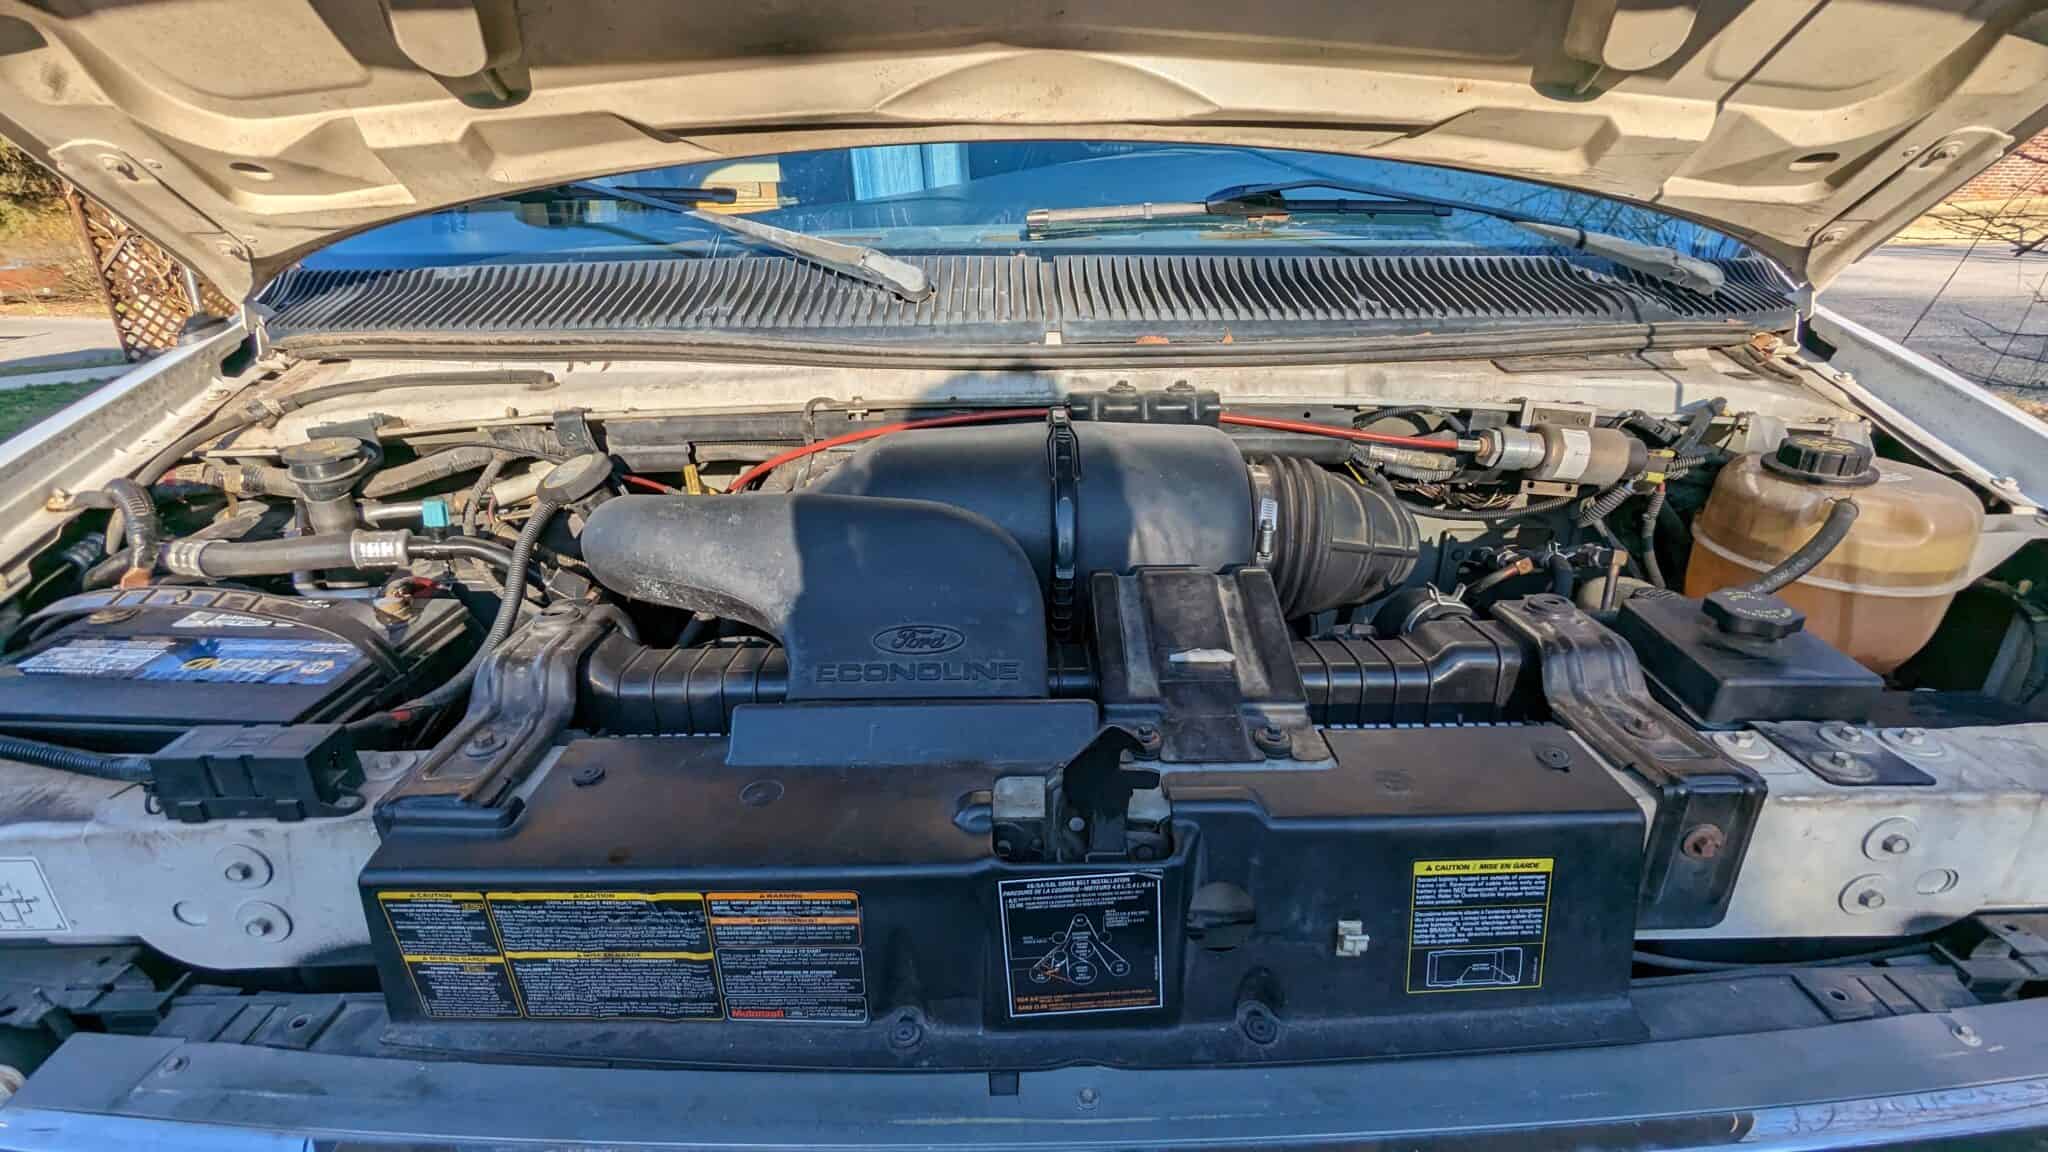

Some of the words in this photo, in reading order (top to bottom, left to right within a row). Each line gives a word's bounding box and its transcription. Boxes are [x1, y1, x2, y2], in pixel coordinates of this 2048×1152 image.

[891, 628, 947, 649] Ford
[815, 662, 1020, 682] ECONOLINE
[732, 1008, 784, 1017] Motorcraft
